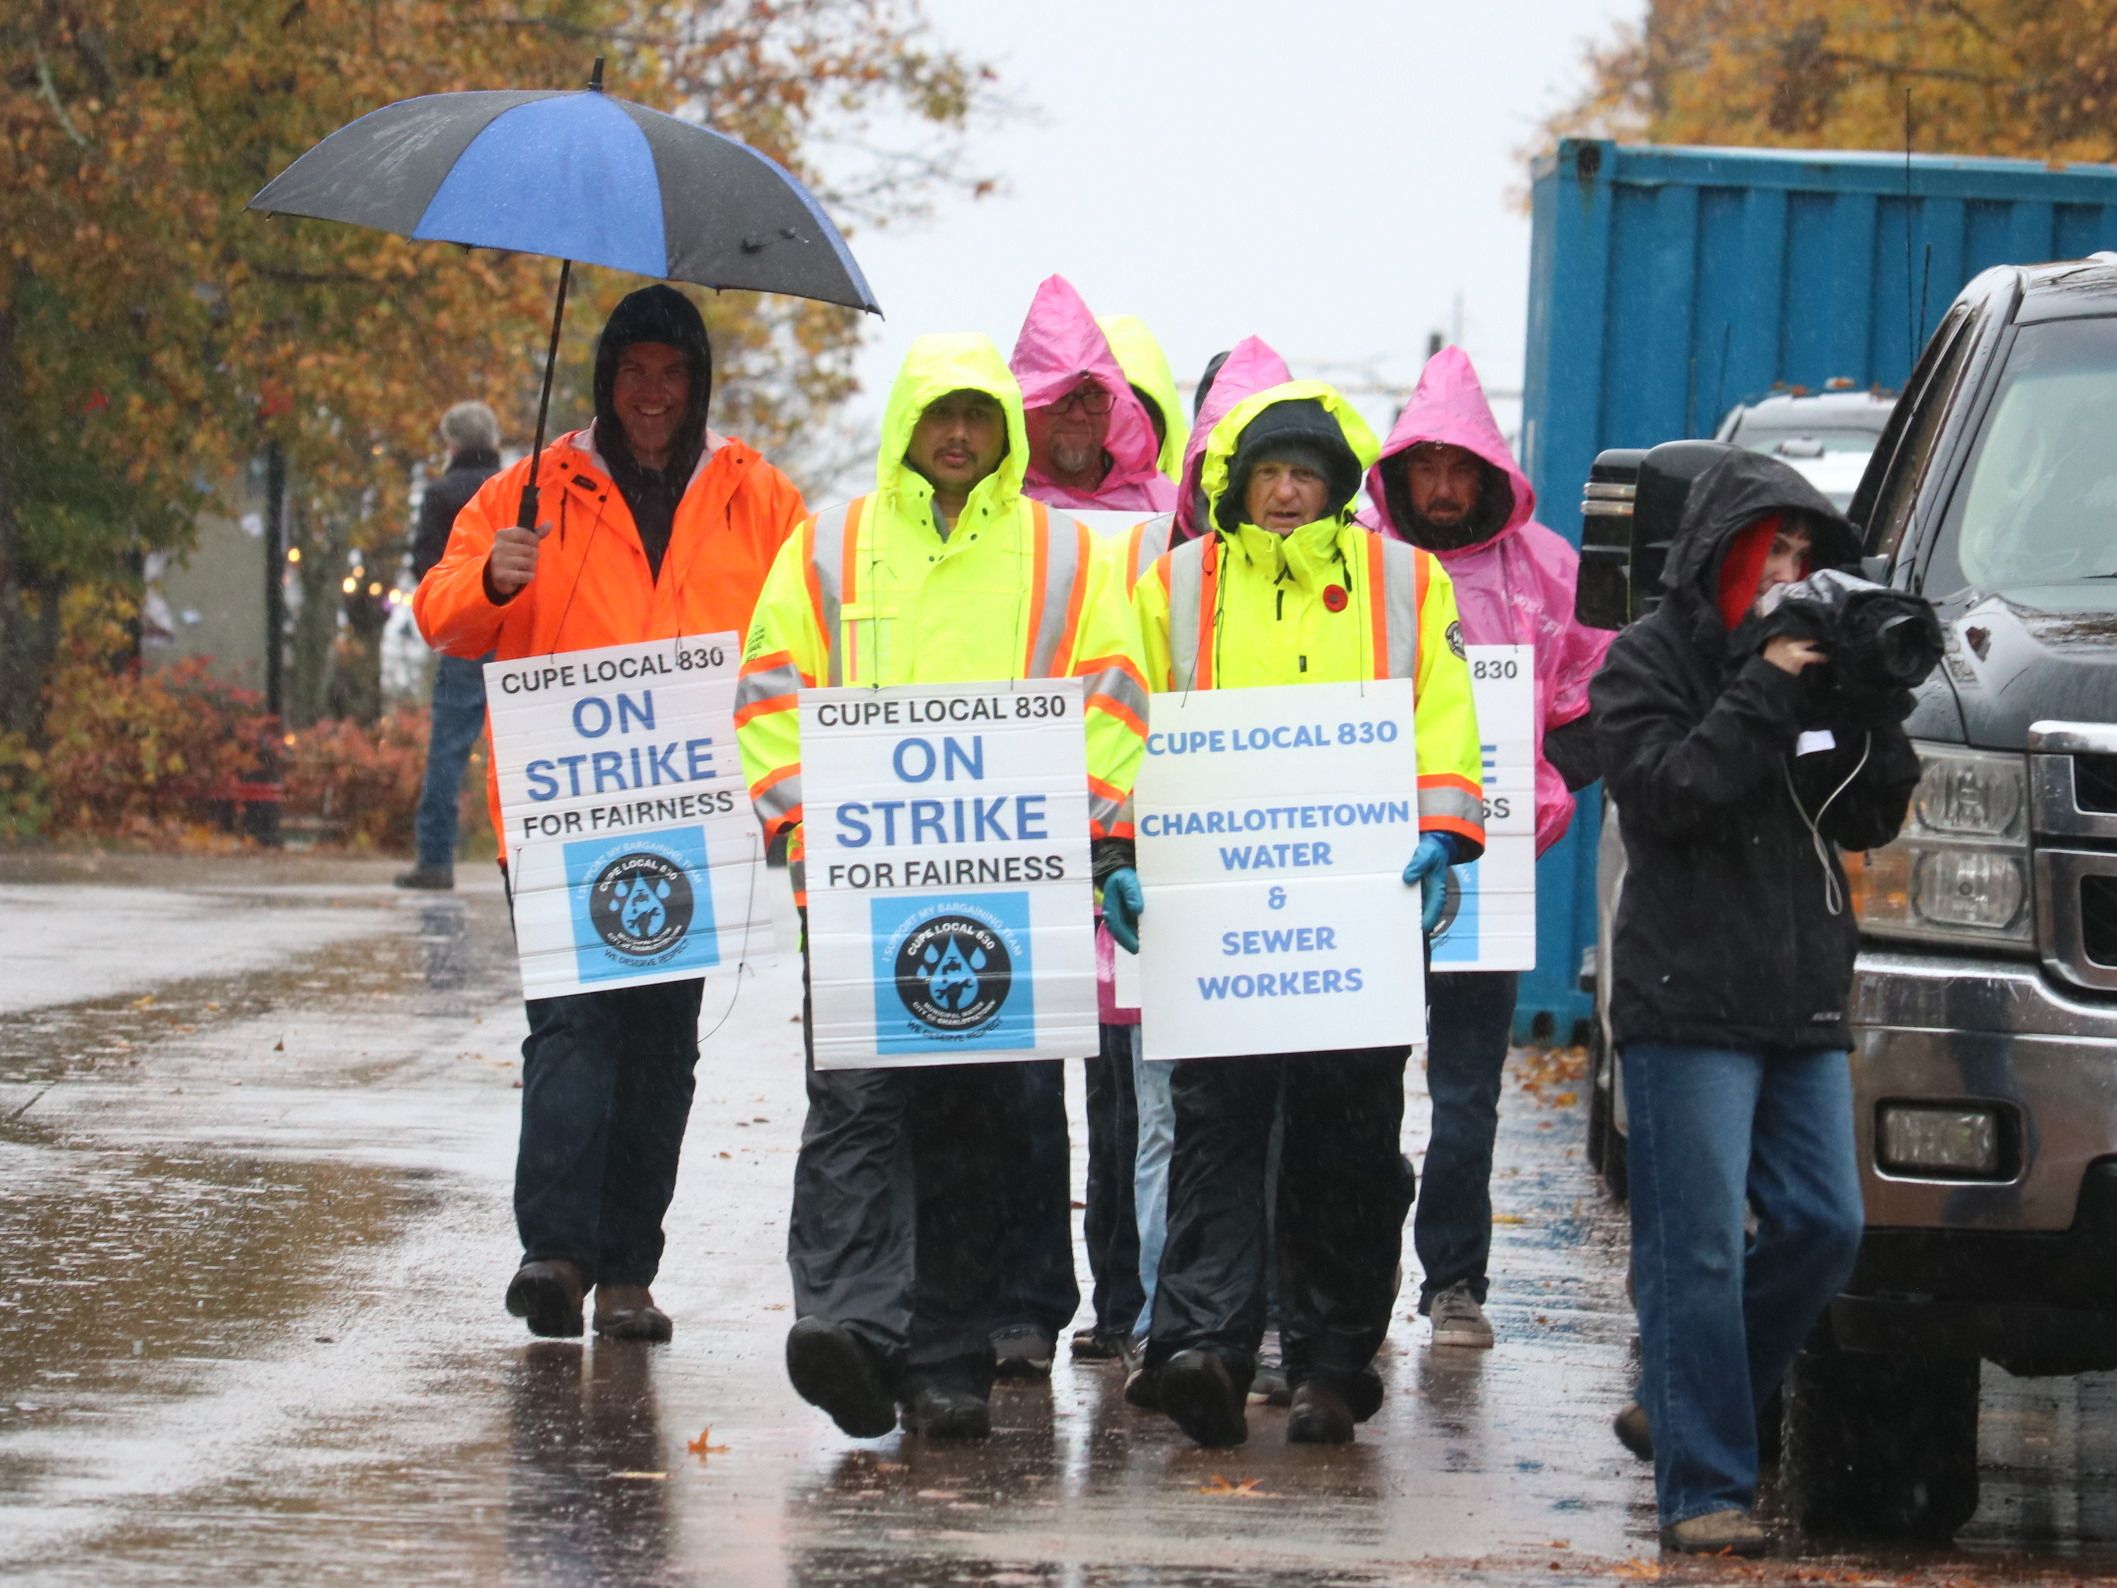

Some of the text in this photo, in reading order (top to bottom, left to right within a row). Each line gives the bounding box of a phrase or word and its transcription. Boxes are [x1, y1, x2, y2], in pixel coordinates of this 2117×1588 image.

[501, 646, 725, 694] CUPE LOCAL 830
[1474, 660, 1518, 680] 830
[572, 690, 656, 738] ON
[817, 695, 1067, 727] CUPE LOCAL 830
[1146, 720, 1399, 756] CUPE LOCAL 830
[525, 737, 718, 801] STRIKE
[892, 735, 985, 783] ON
[523, 790, 735, 839] FOR FAIRNESS
[835, 794, 1049, 849] STRIKE
[1140, 800, 1410, 837] CHARLOTTETOWN
[622, 859, 658, 871] LOCAL
[829, 855, 1065, 889] FOR FAIRNESS
[1219, 841, 1334, 871] WATER
[1267, 886, 1288, 910] &
[907, 922, 996, 956] CUPE LOCAL 830
[1221, 927, 1338, 956] SEWER
[1197, 967, 1364, 1001] WORKERS
